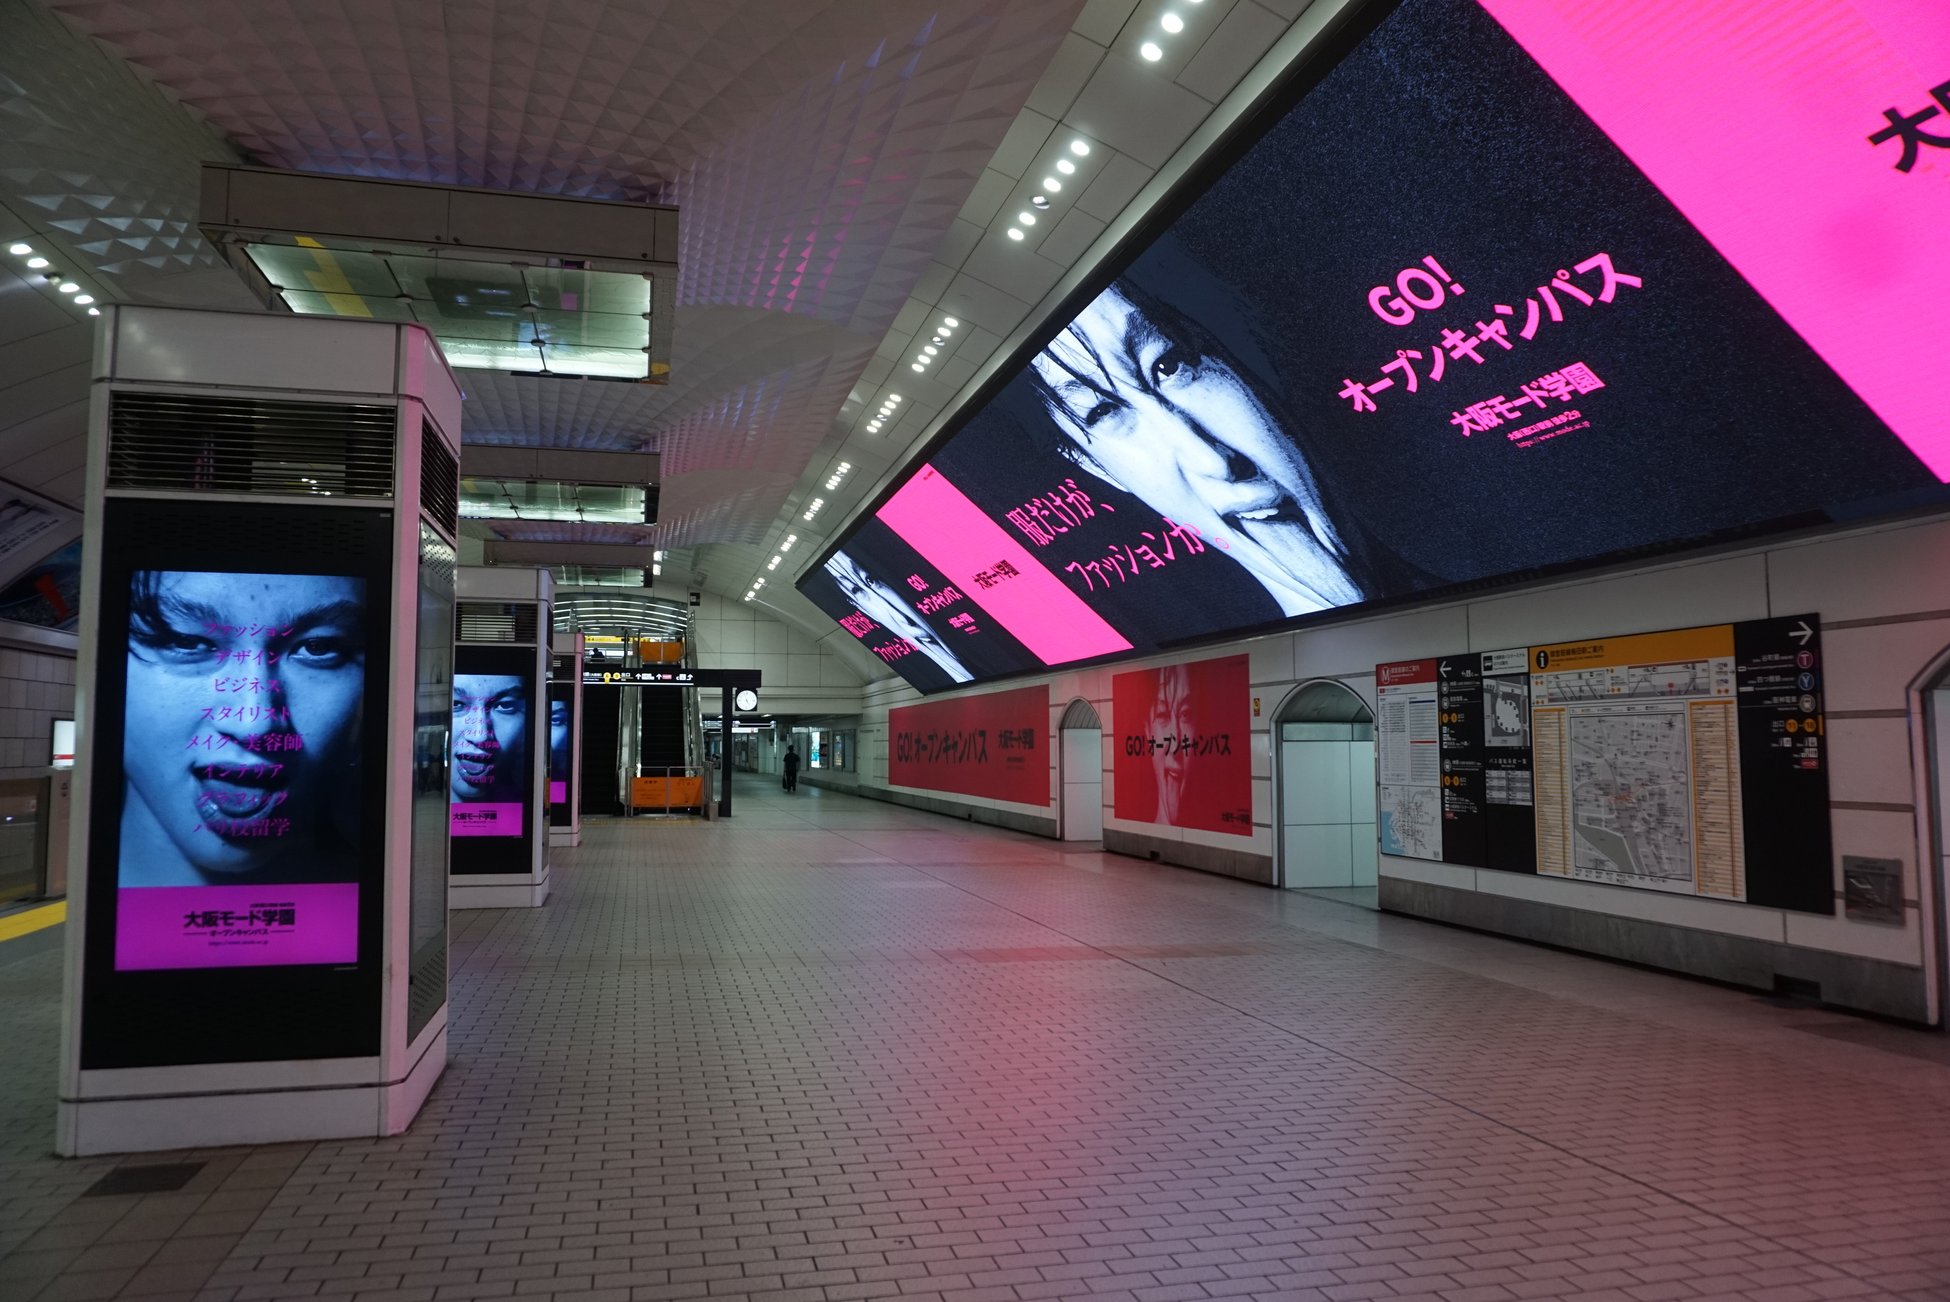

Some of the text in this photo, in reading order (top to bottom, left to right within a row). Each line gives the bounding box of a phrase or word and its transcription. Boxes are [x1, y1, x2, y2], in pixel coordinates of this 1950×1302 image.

[1368, 255, 1466, 326] GO!
[1338, 252, 1643, 413] オープンキャンパス
[1450, 361, 1606, 438] 大阪モード学園
[1005, 478, 1115, 548] 服だけが、
[907, 573, 930, 592] GO!
[203, 622, 296, 638] ファッション
[214, 648, 282, 666] デザイン
[213, 677, 282, 695] ビジネス
[201, 705, 293, 723] スタイリスト
[185, 733, 304, 752] メイク・美容師
[897, 731, 913, 763] GO!
[914, 728, 989, 764] オープンキャンパス
[1125, 733, 1232, 758] GO! オープンキャンパス
[203, 763, 285, 780] インテリア
[182, 909, 296, 929] 大阪モード学園
